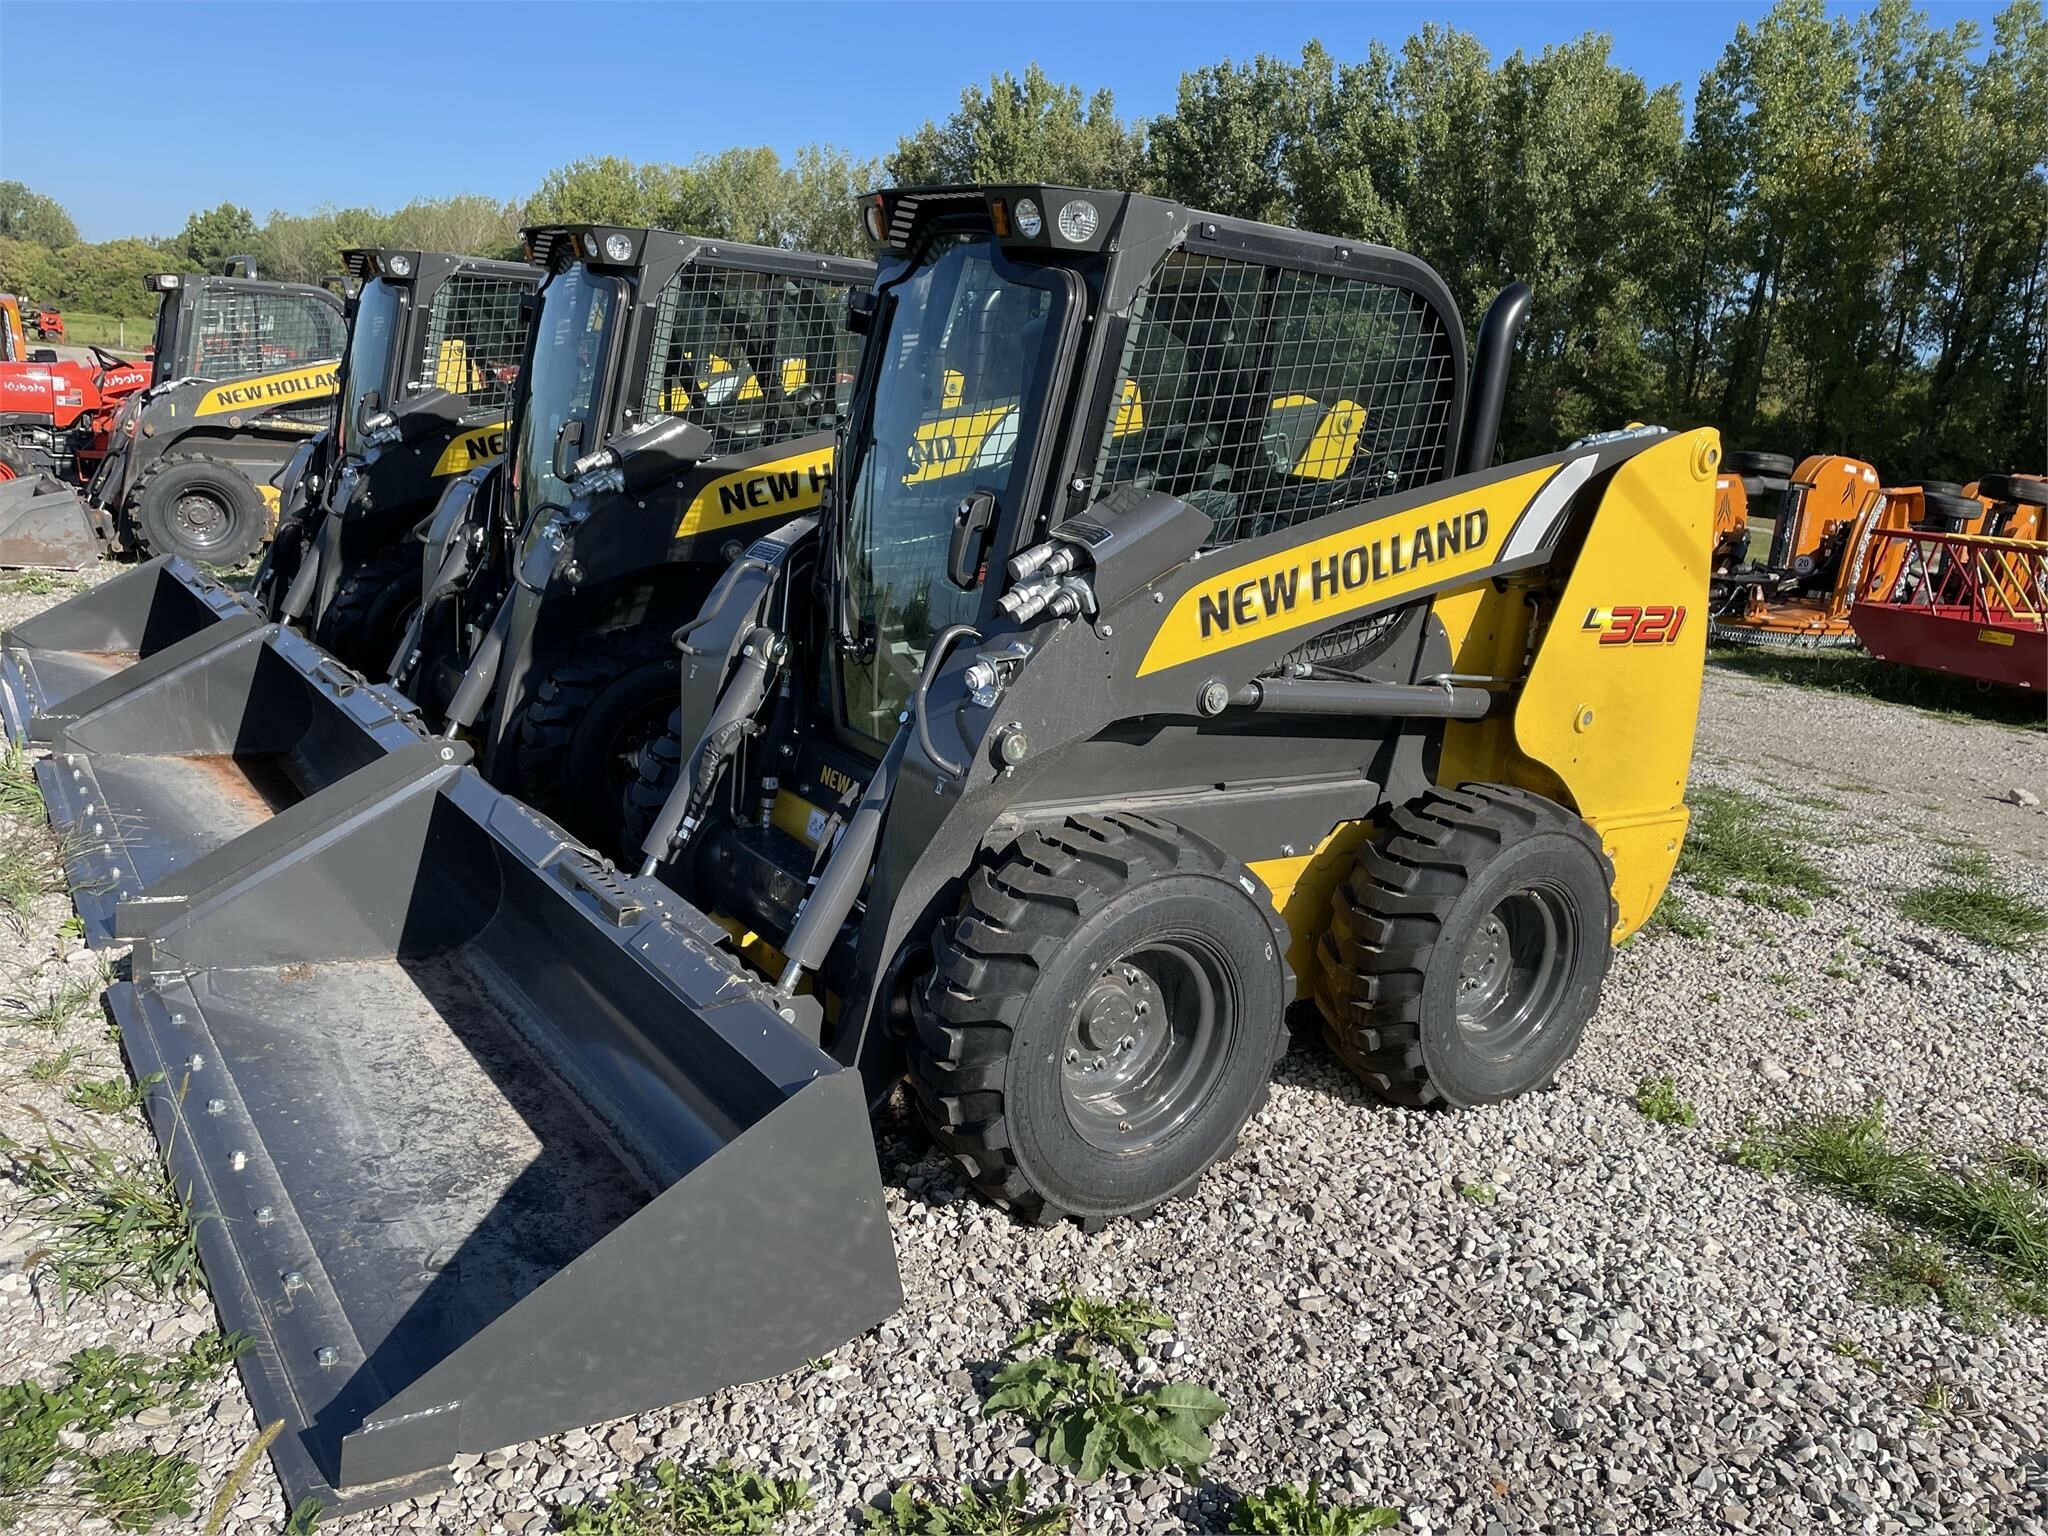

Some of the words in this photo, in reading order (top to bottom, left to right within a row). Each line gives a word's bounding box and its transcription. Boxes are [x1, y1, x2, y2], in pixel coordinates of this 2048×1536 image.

[4, 381, 46, 393] Kubota
[217, 386, 262, 406] NEW
[718, 470, 799, 515] NEW
[1200, 565, 1300, 640] NEW
[1310, 508, 1489, 602] HOLLAND
[1582, 606, 1686, 645] L321
[819, 765, 850, 793] NEW
